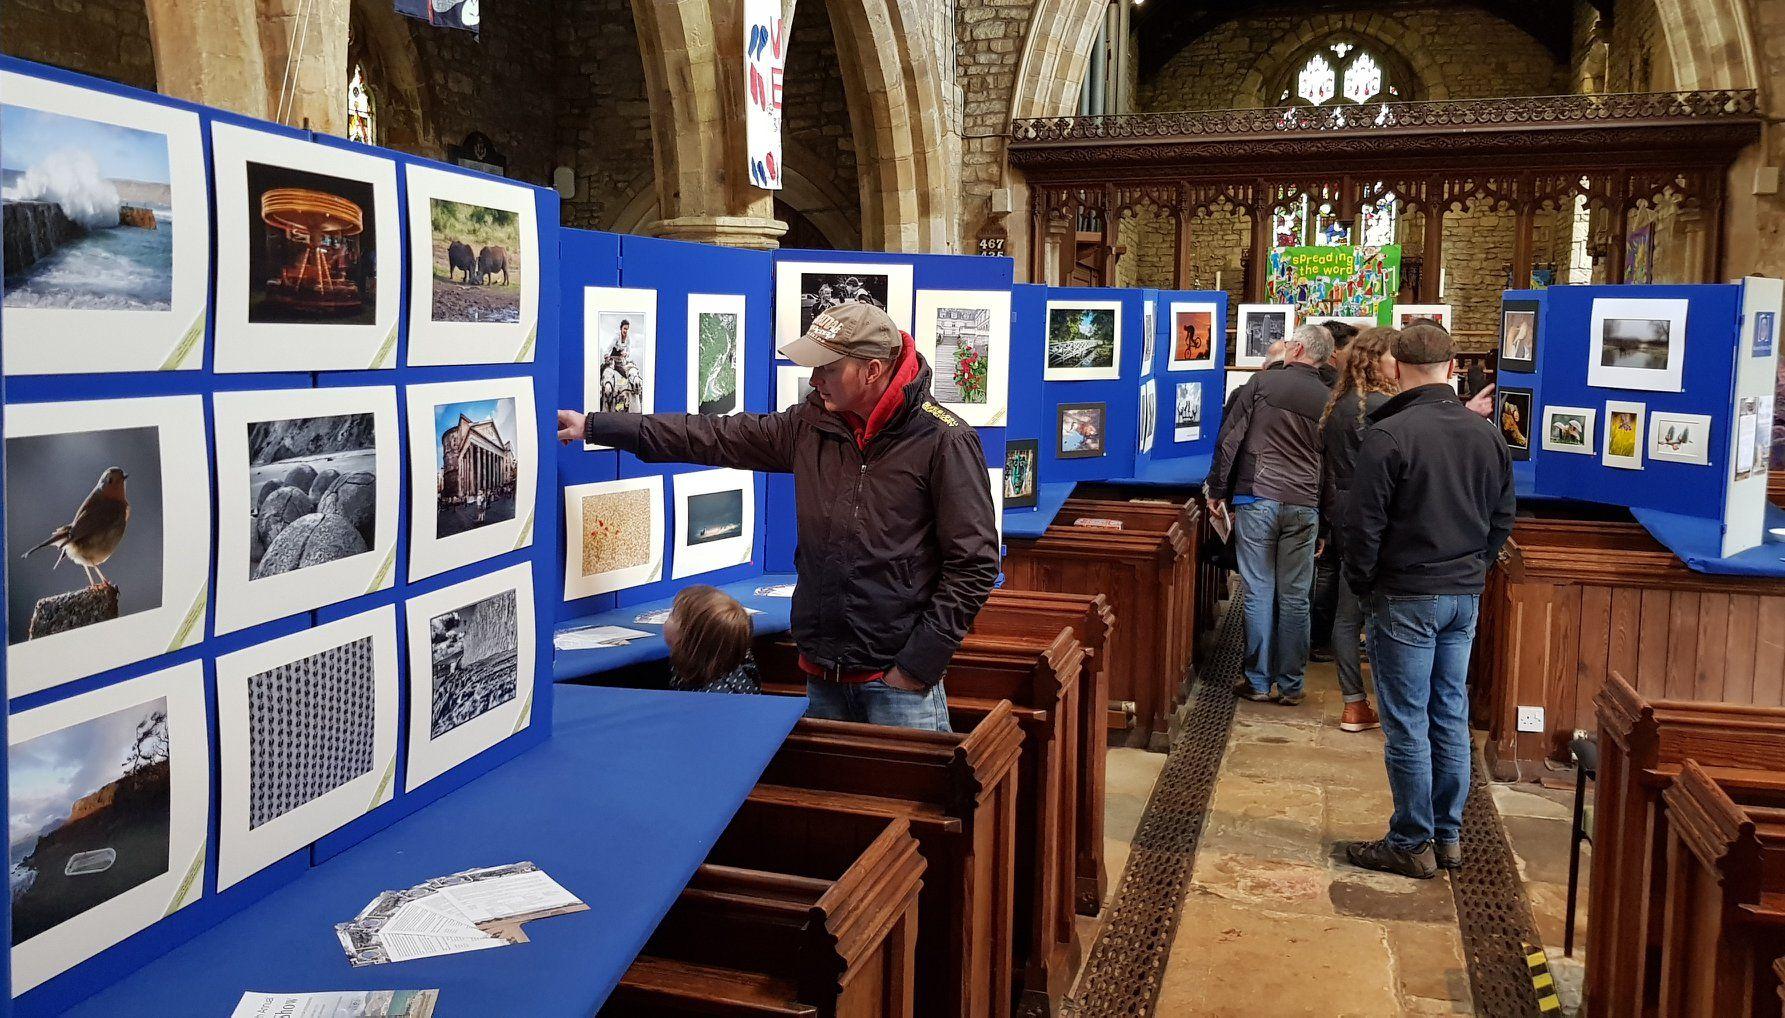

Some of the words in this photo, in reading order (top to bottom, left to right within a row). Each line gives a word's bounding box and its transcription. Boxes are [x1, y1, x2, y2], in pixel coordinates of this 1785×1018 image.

[979, 238, 1004, 250] 467
[1292, 252, 1354, 266] spreading
[1299, 265, 1319, 276] the
[1323, 264, 1354, 276] word
